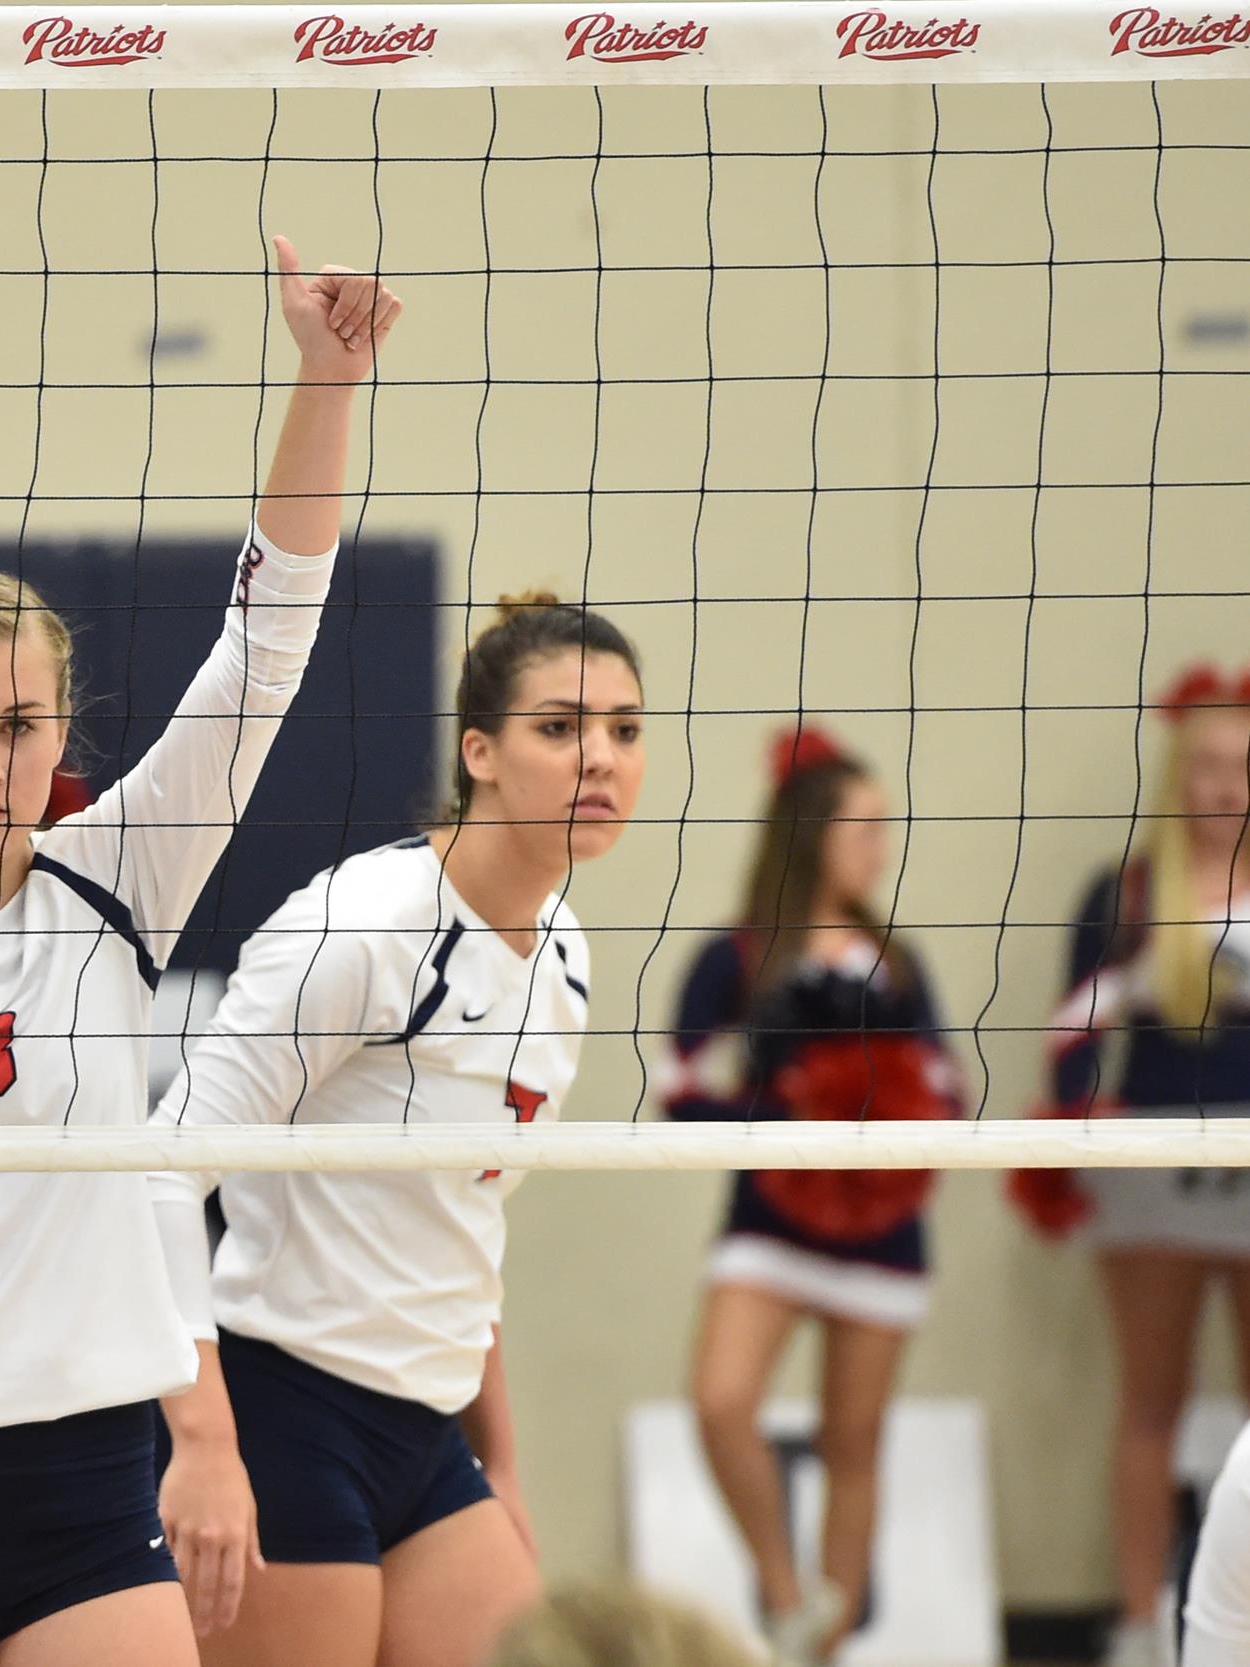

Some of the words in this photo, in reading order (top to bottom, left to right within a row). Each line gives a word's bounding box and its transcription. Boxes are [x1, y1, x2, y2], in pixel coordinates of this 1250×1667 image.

[21, 16, 168, 68] Patriots
[293, 14, 437, 66] Patriots
[563, 12, 709, 64] Patriots
[835, 10, 982, 62] Patriots
